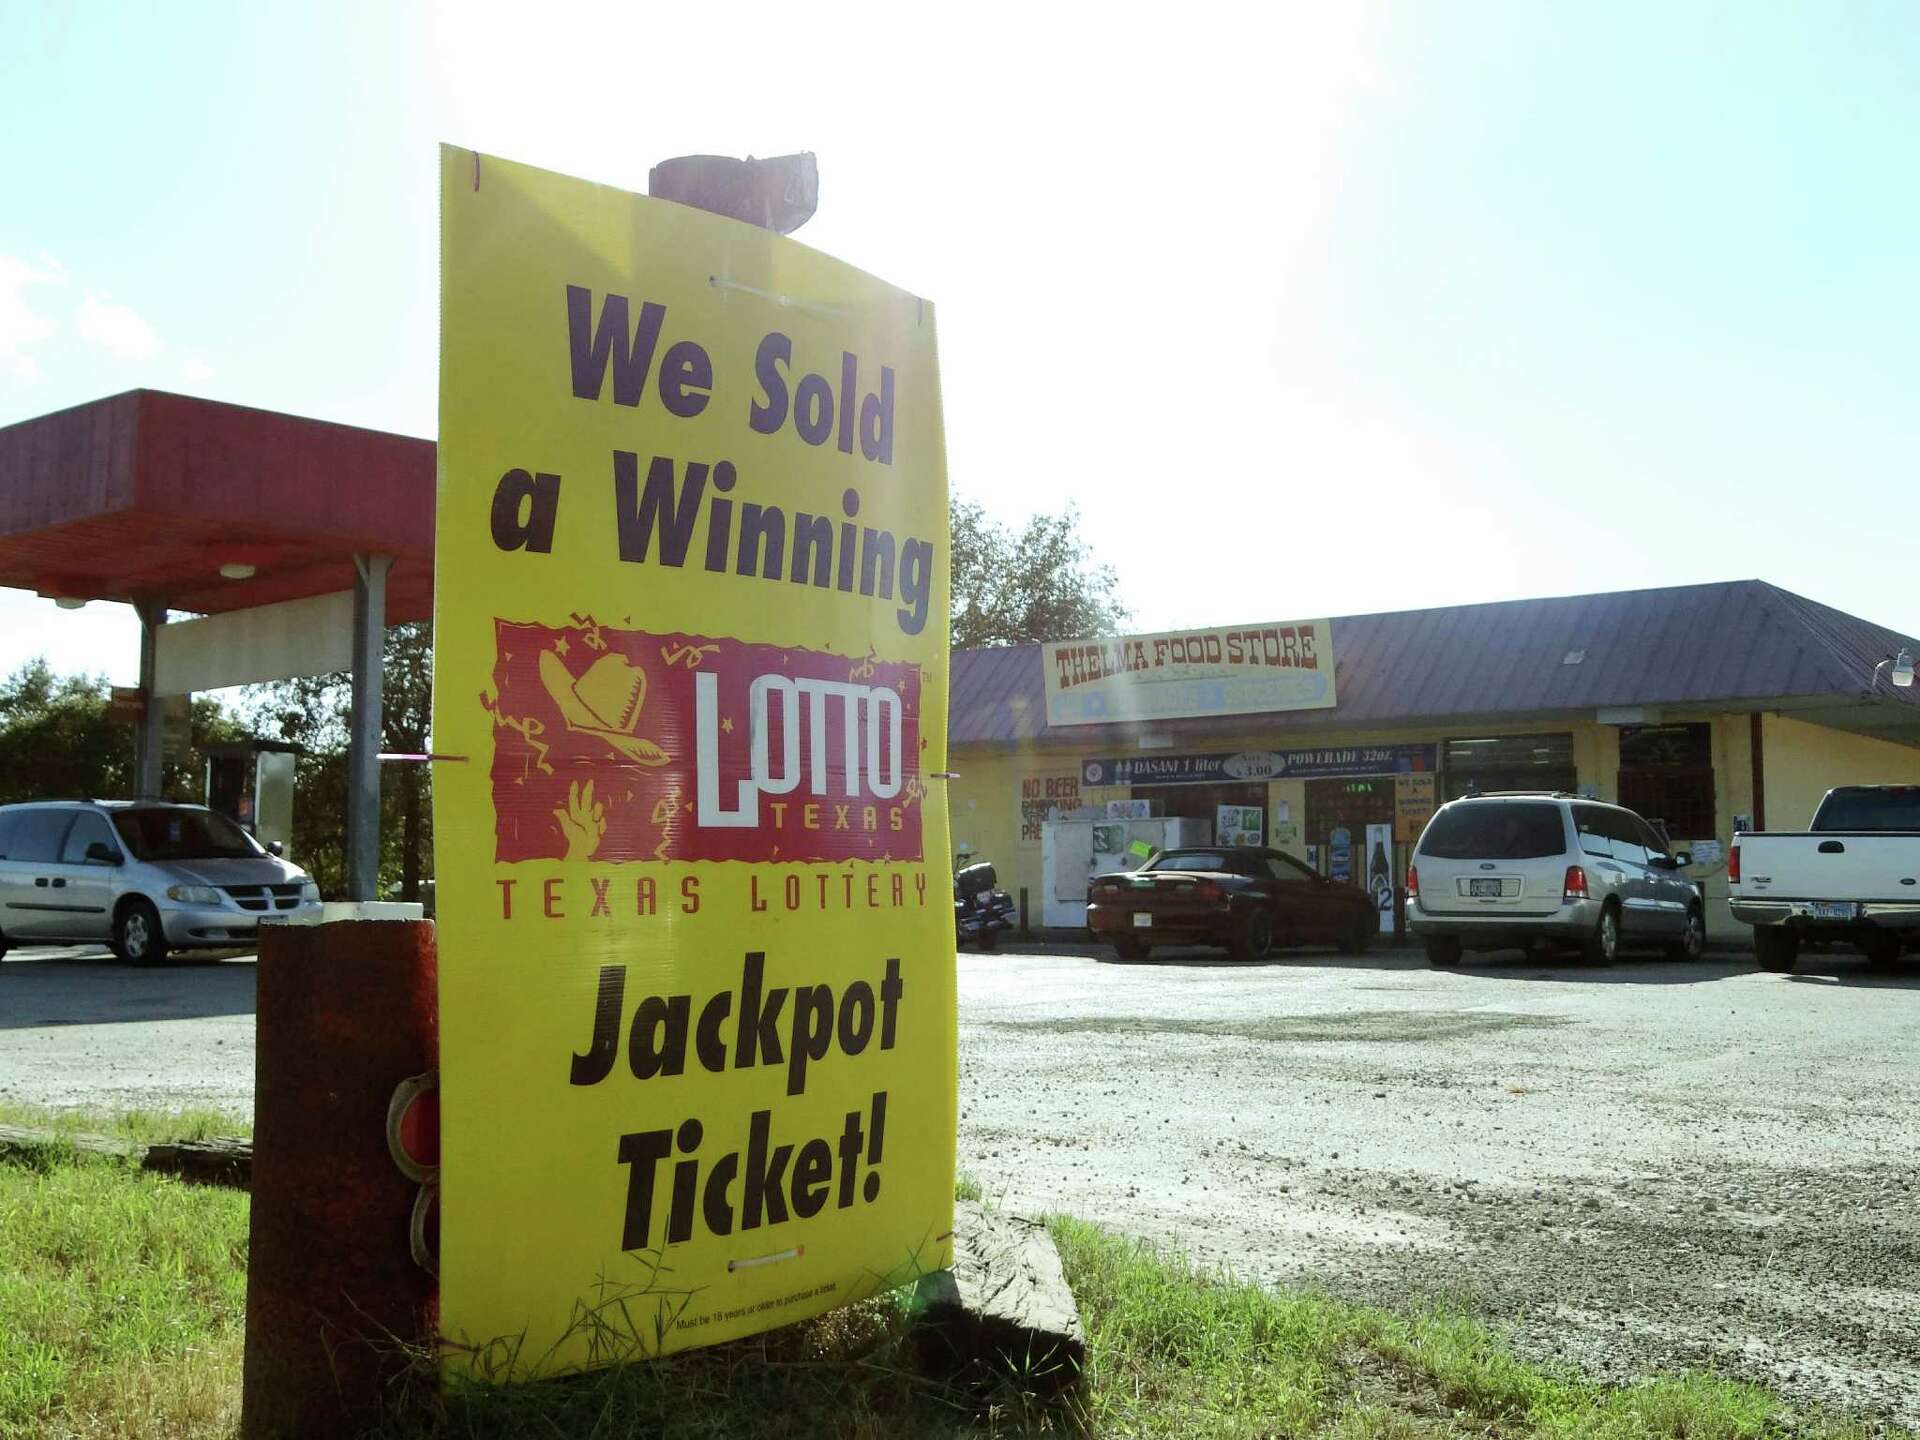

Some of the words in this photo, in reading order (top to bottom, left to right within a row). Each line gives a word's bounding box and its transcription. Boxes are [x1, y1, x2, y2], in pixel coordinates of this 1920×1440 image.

[566, 285, 713, 418] We
[749, 332, 895, 465] Sold
[490, 468, 562, 554] a
[612, 450, 933, 636] Winning
[1056, 641, 1149, 689] THELMA
[1153, 634, 1222, 667] FOOD
[1226, 624, 1318, 671] STORE
[695, 671, 902, 827] LOTTO
[1134, 757, 1179, 775] DASANI
[1184, 757, 1191, 773] 1
[1287, 750, 1357, 766] POWERADE
[1023, 778, 1041, 799] NO
[1046, 775, 1079, 798] BEER
[771, 802, 904, 831] TEXAS
[496, 876, 700, 920] TEXAS
[751, 872, 927, 912] LOTTERY
[570, 951, 903, 1096] Jackpot
[617, 1091, 887, 1252] Ticket!
[676, 1318, 697, 1331] Must
[713, 1311, 723, 1322] 18
[724, 1307, 746, 1322] years
